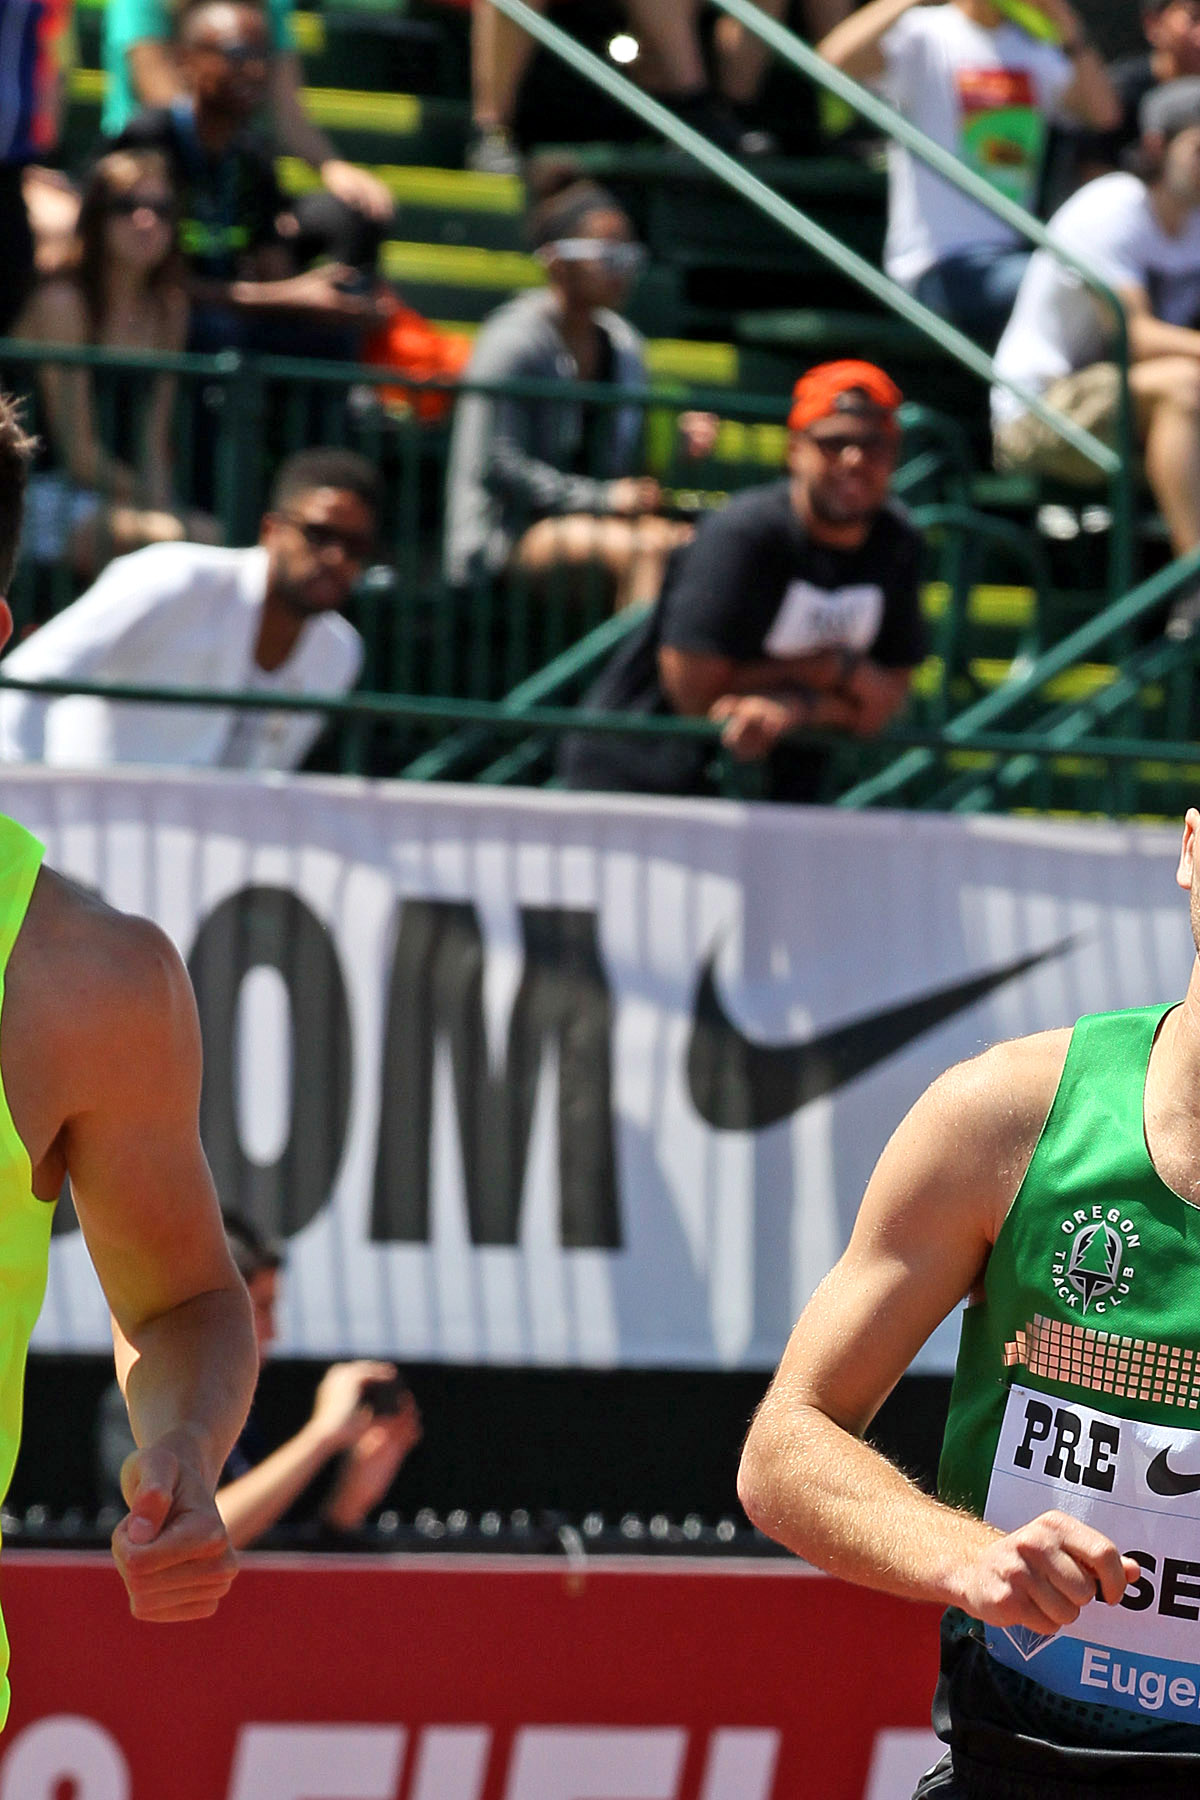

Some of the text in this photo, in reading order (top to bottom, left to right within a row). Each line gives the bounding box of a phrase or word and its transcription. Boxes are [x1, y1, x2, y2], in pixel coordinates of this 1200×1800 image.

[52, 885, 624, 1250] OM
[1061, 1205, 1141, 1248] OREGON
[1052, 1251, 1079, 1308] TRACK
[1095, 1266, 1135, 1313] CLUB
[1014, 1399, 1120, 1493] PRE
